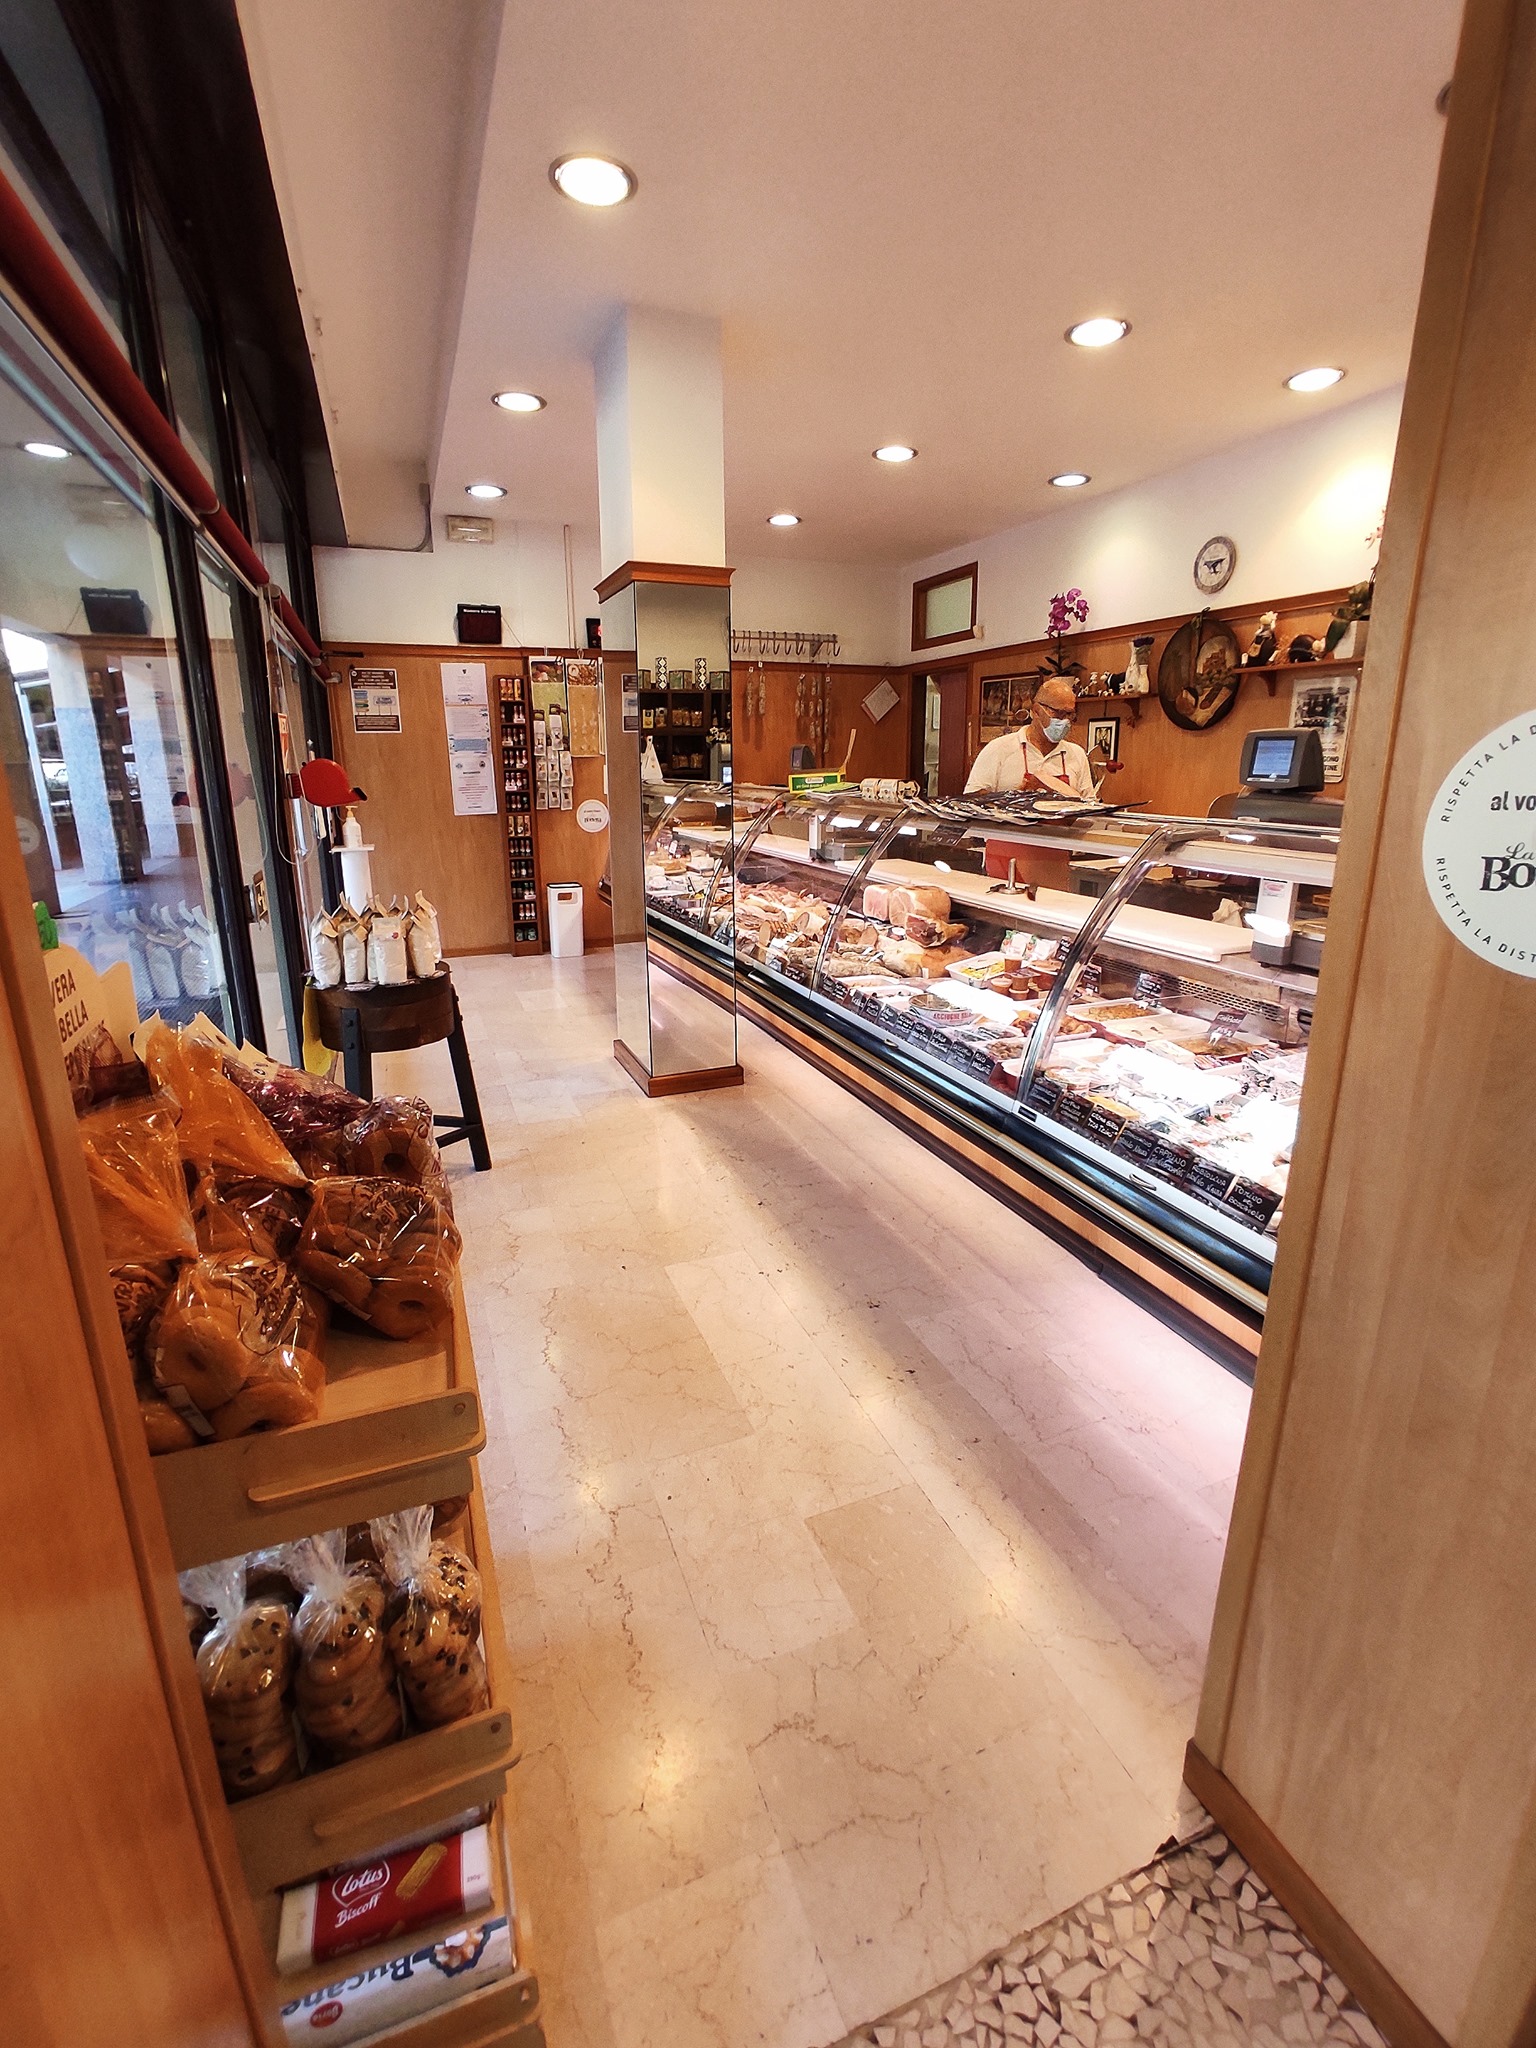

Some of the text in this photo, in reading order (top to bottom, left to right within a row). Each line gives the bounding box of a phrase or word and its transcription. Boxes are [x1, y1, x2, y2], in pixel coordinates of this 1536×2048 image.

[1440, 753, 1494, 822] RISPETTA
[1498, 734, 1521, 751] LA
[1490, 791, 1509, 811] al
[1505, 841, 1536, 861] La
[1436, 857, 1472, 927] RISPETTA
[1474, 928, 1492, 945] LA
[58, 999, 89, 1044] BELLA
[1154, 1146, 1187, 1168] CAPRINO
[341, 1866, 384, 1897] Lotus
[335, 1891, 382, 1928] Biscoff
